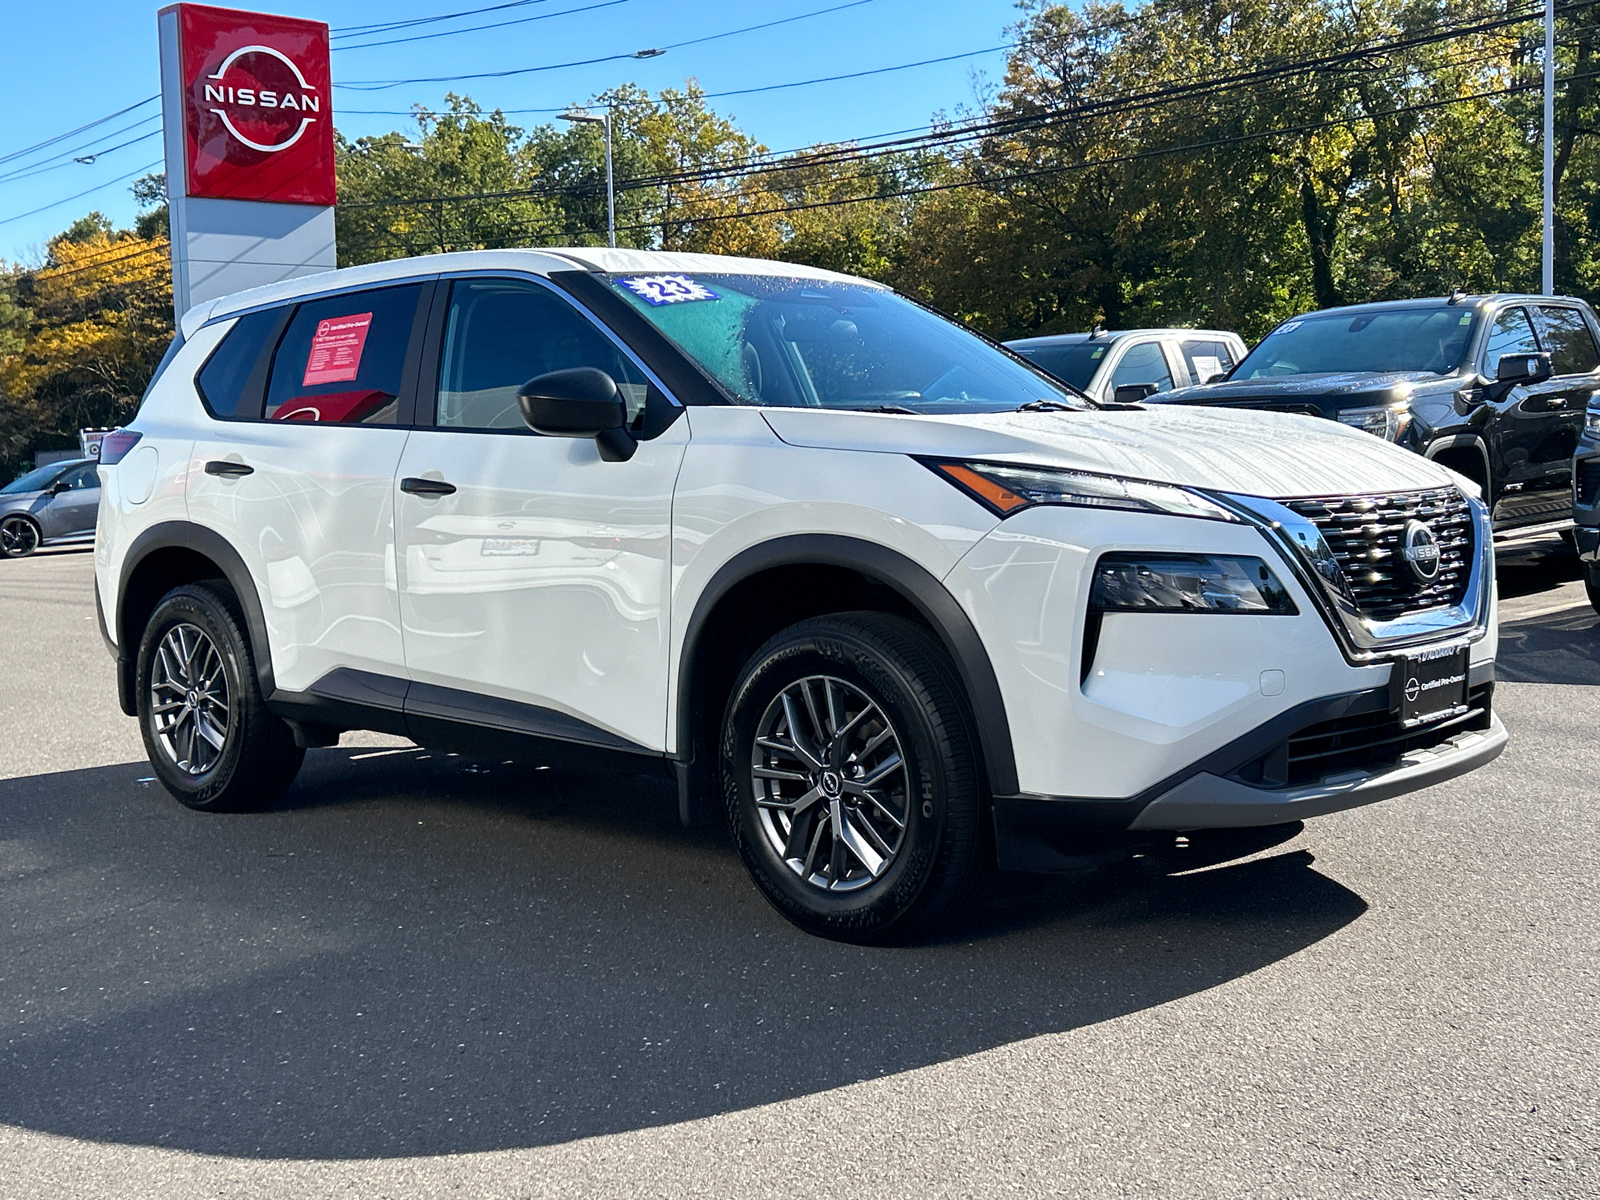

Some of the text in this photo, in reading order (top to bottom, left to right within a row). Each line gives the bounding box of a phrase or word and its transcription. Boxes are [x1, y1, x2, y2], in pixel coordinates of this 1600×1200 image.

[204, 84, 320, 113] NISSAN
[645, 279, 693, 297] 23
[1420, 679, 1441, 691] Certified
